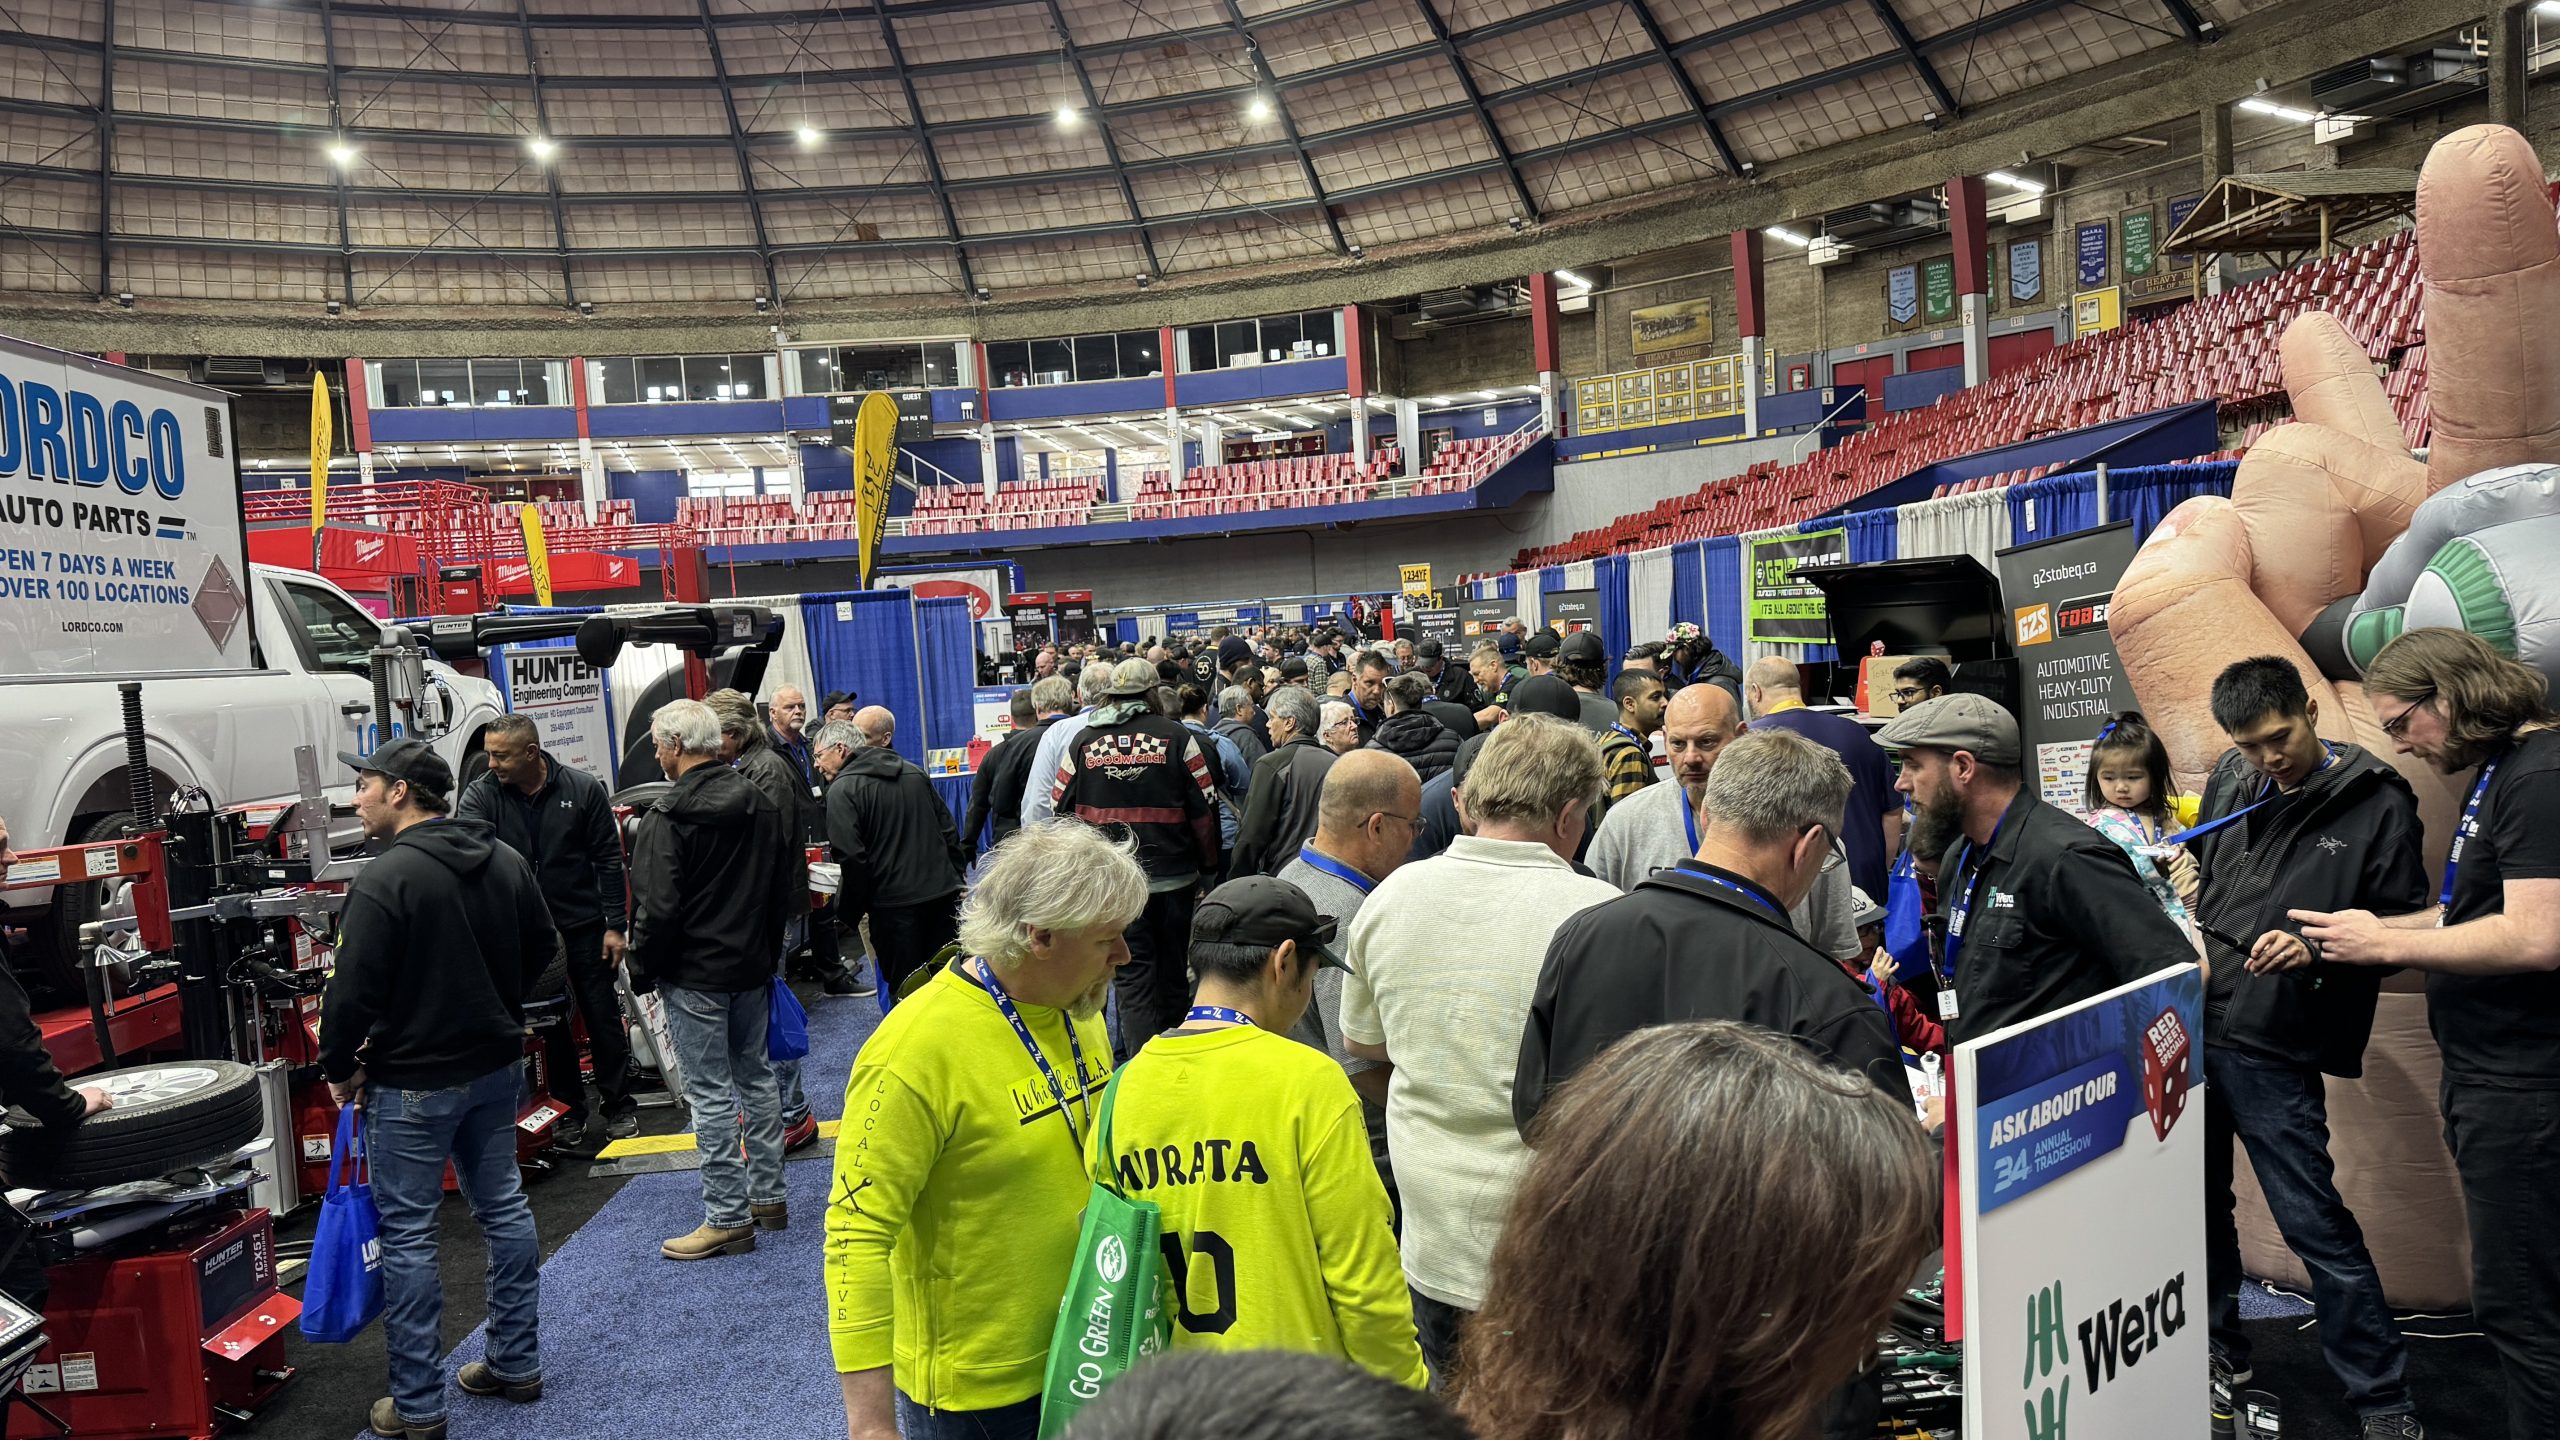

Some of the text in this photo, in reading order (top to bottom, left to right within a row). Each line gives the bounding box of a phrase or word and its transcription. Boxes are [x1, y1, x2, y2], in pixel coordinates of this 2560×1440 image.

[2146, 273, 2177, 287] HEAVY
[1965, 314, 1971, 324] 2
[902, 393, 922, 401] GUEST
[361, 466, 372, 475] 22
[582, 461, 591, 470] 22
[788, 456, 797, 464] 23
[873, 446, 899, 546] THE POWER YOU NEED
[73, 502, 151, 536] PARTS
[186, 532, 197, 541] TM
[41, 552, 52, 572] 7
[59, 553, 106, 576] DAYS
[112, 557, 124, 577] A
[127, 558, 176, 580] WEEK
[1403, 569, 1427, 581] 1234YF
[2033, 561, 2097, 589] g2stobeq.ca
[0, 576, 189, 605] OVER 100 LOCATIONS
[838, 606, 851, 614] A20
[1774, 604, 1784, 615] ALL
[1786, 603, 1803, 615] ABOUT
[1804, 603, 1815, 615] THE
[2058, 603, 2109, 629] TOBE
[62, 621, 124, 633] LORDCO.COM
[2017, 606, 2048, 644] G2S
[2037, 652, 2112, 679] AUTOMOTIVE
[513, 683, 600, 704] Engineering Company
[2038, 675, 2113, 700] HEAVY-DUTY
[2043, 697, 2112, 721] INDUSTRIAL
[1085, 752, 1167, 769] Goodwrench
[1103, 765, 1149, 782] Racing
[2450, 836, 2465, 863] LORDCO
[1952, 909, 1966, 937] LORDCO
[2147, 1011, 2176, 1046] RED
[2155, 1023, 2182, 1058] SHEET
[2159, 1033, 2186, 1067] SPECIALS
[1012, 1069, 1079, 1116] Whisler
[853, 1080, 886, 1168] LOCAL
[1989, 1071, 2117, 1150] ASK ABOUT OUR
[2034, 1128, 2072, 1157] ANNUAL
[2034, 1133, 2092, 1173] TRADESHOW
[1119, 1139, 1268, 1191] MURATA
[204, 1240, 243, 1271] HUNTER
[252, 1233, 265, 1282] TCX51
[1069, 1285, 1114, 1399] GO GREEN
[2077, 1270, 2186, 1396] Wera
